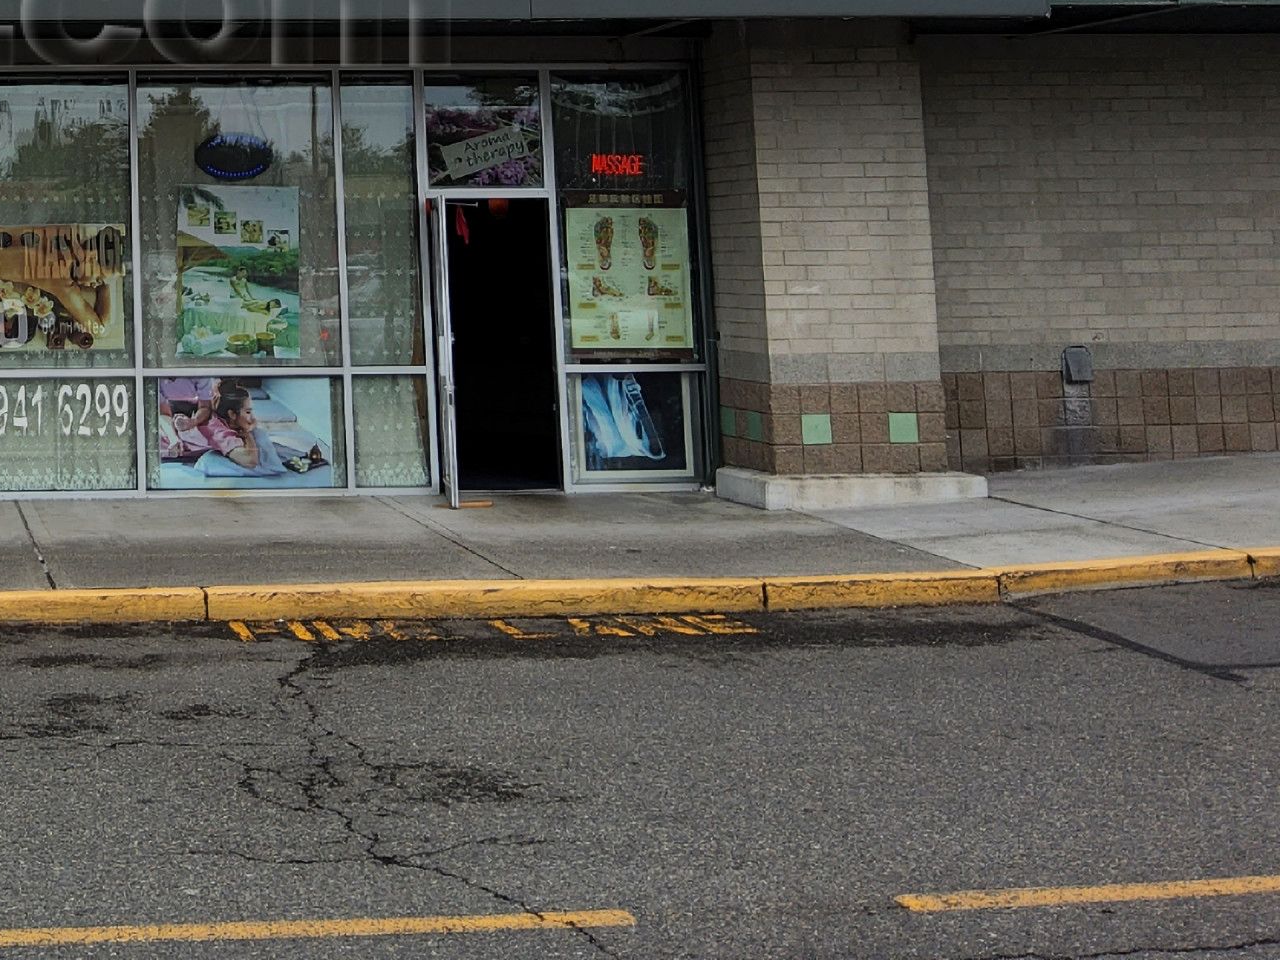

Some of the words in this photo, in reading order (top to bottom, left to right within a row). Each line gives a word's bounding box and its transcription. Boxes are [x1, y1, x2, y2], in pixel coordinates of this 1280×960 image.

[464, 133, 511, 152] Aroma
[465, 142, 525, 167] therapy
[592, 153, 644, 174] MASSAGE
[58, 384, 128, 436] 6299
